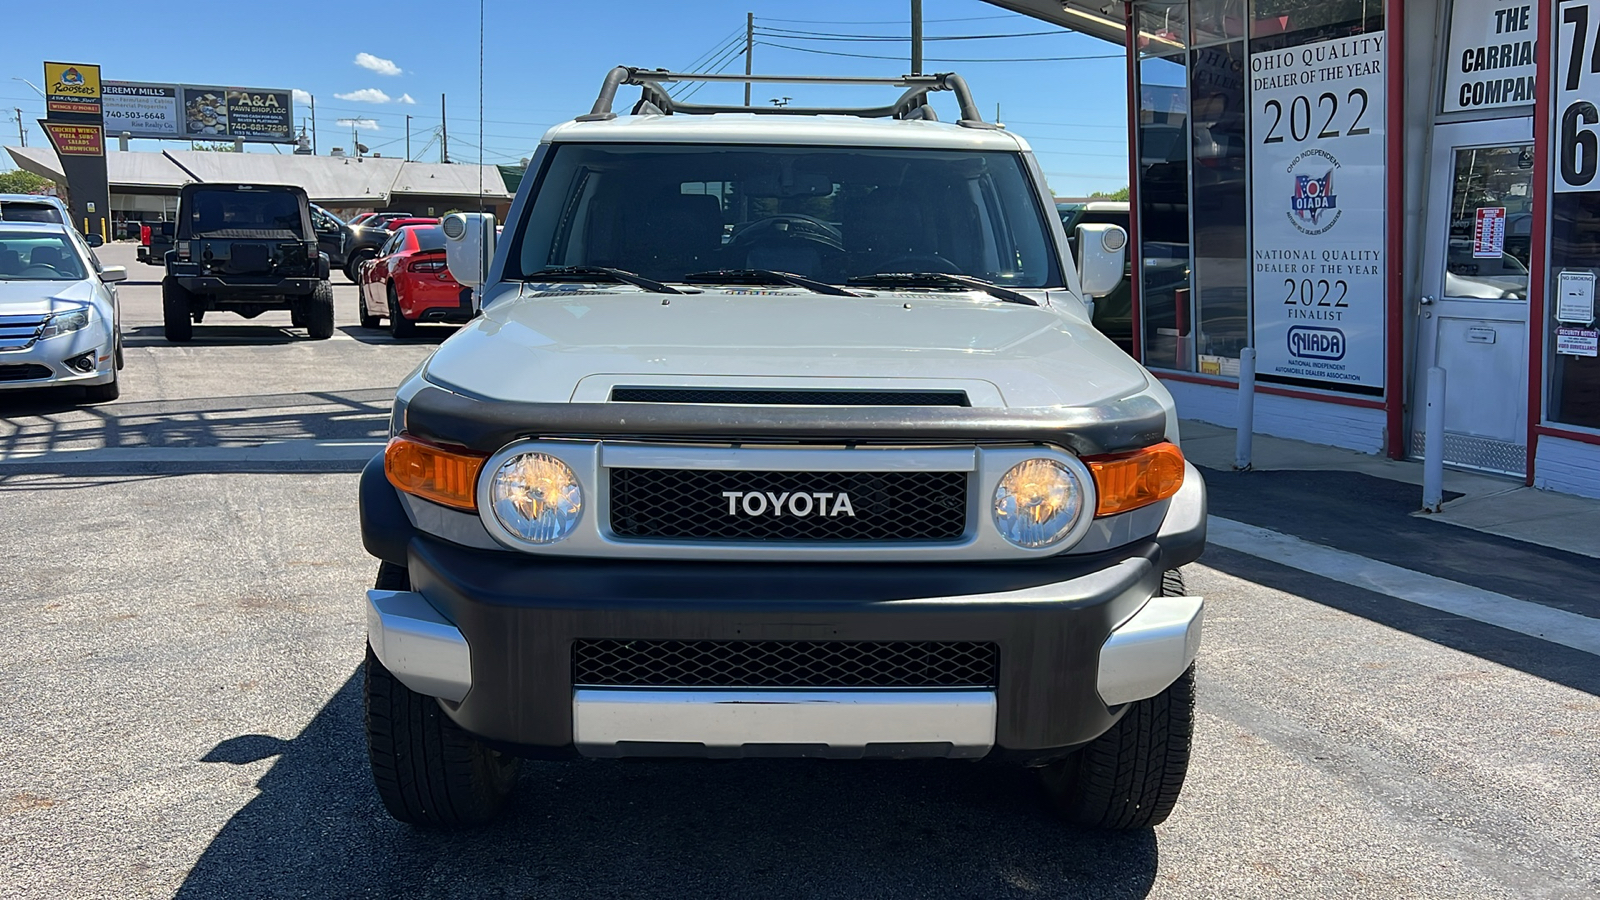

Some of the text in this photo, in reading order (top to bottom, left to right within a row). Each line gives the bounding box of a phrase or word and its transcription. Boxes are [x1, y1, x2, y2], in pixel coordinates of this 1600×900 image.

[1494, 5, 1531, 34] THE
[1252, 36, 1384, 73] OHIO QUALITY
[1254, 72, 1298, 91] DEALER
[1300, 69, 1316, 85] OF
[1318, 65, 1344, 82] THE
[1346, 59, 1381, 78] YEAR
[52, 82, 95, 95] Roosters
[102, 86, 165, 96] JEREMY MILLS
[238, 92, 279, 108] A&A
[105, 110, 165, 120] 740-503-6648
[1263, 87, 1371, 145] 2022
[145, 121, 162, 129] Realty
[1286, 148, 1342, 173] OHIO INDEPENDENT
[1296, 197, 1329, 209] OIADA
[1255, 249, 1380, 262] NATIONAL QUALITY
[1256, 263, 1379, 275] DEALER OF THE YEAR
[1283, 278, 1349, 308] 2022
[1287, 308, 1343, 321] FINALIST
[1580, 330, 1597, 338] NOTICE
[1288, 359, 1346, 371] NATIONAL INDEPENDENT
[1275, 366, 1361, 381] AUTOMOBILE DEALERS ASSOCIATION
[722, 491, 856, 517] TOYOTA
